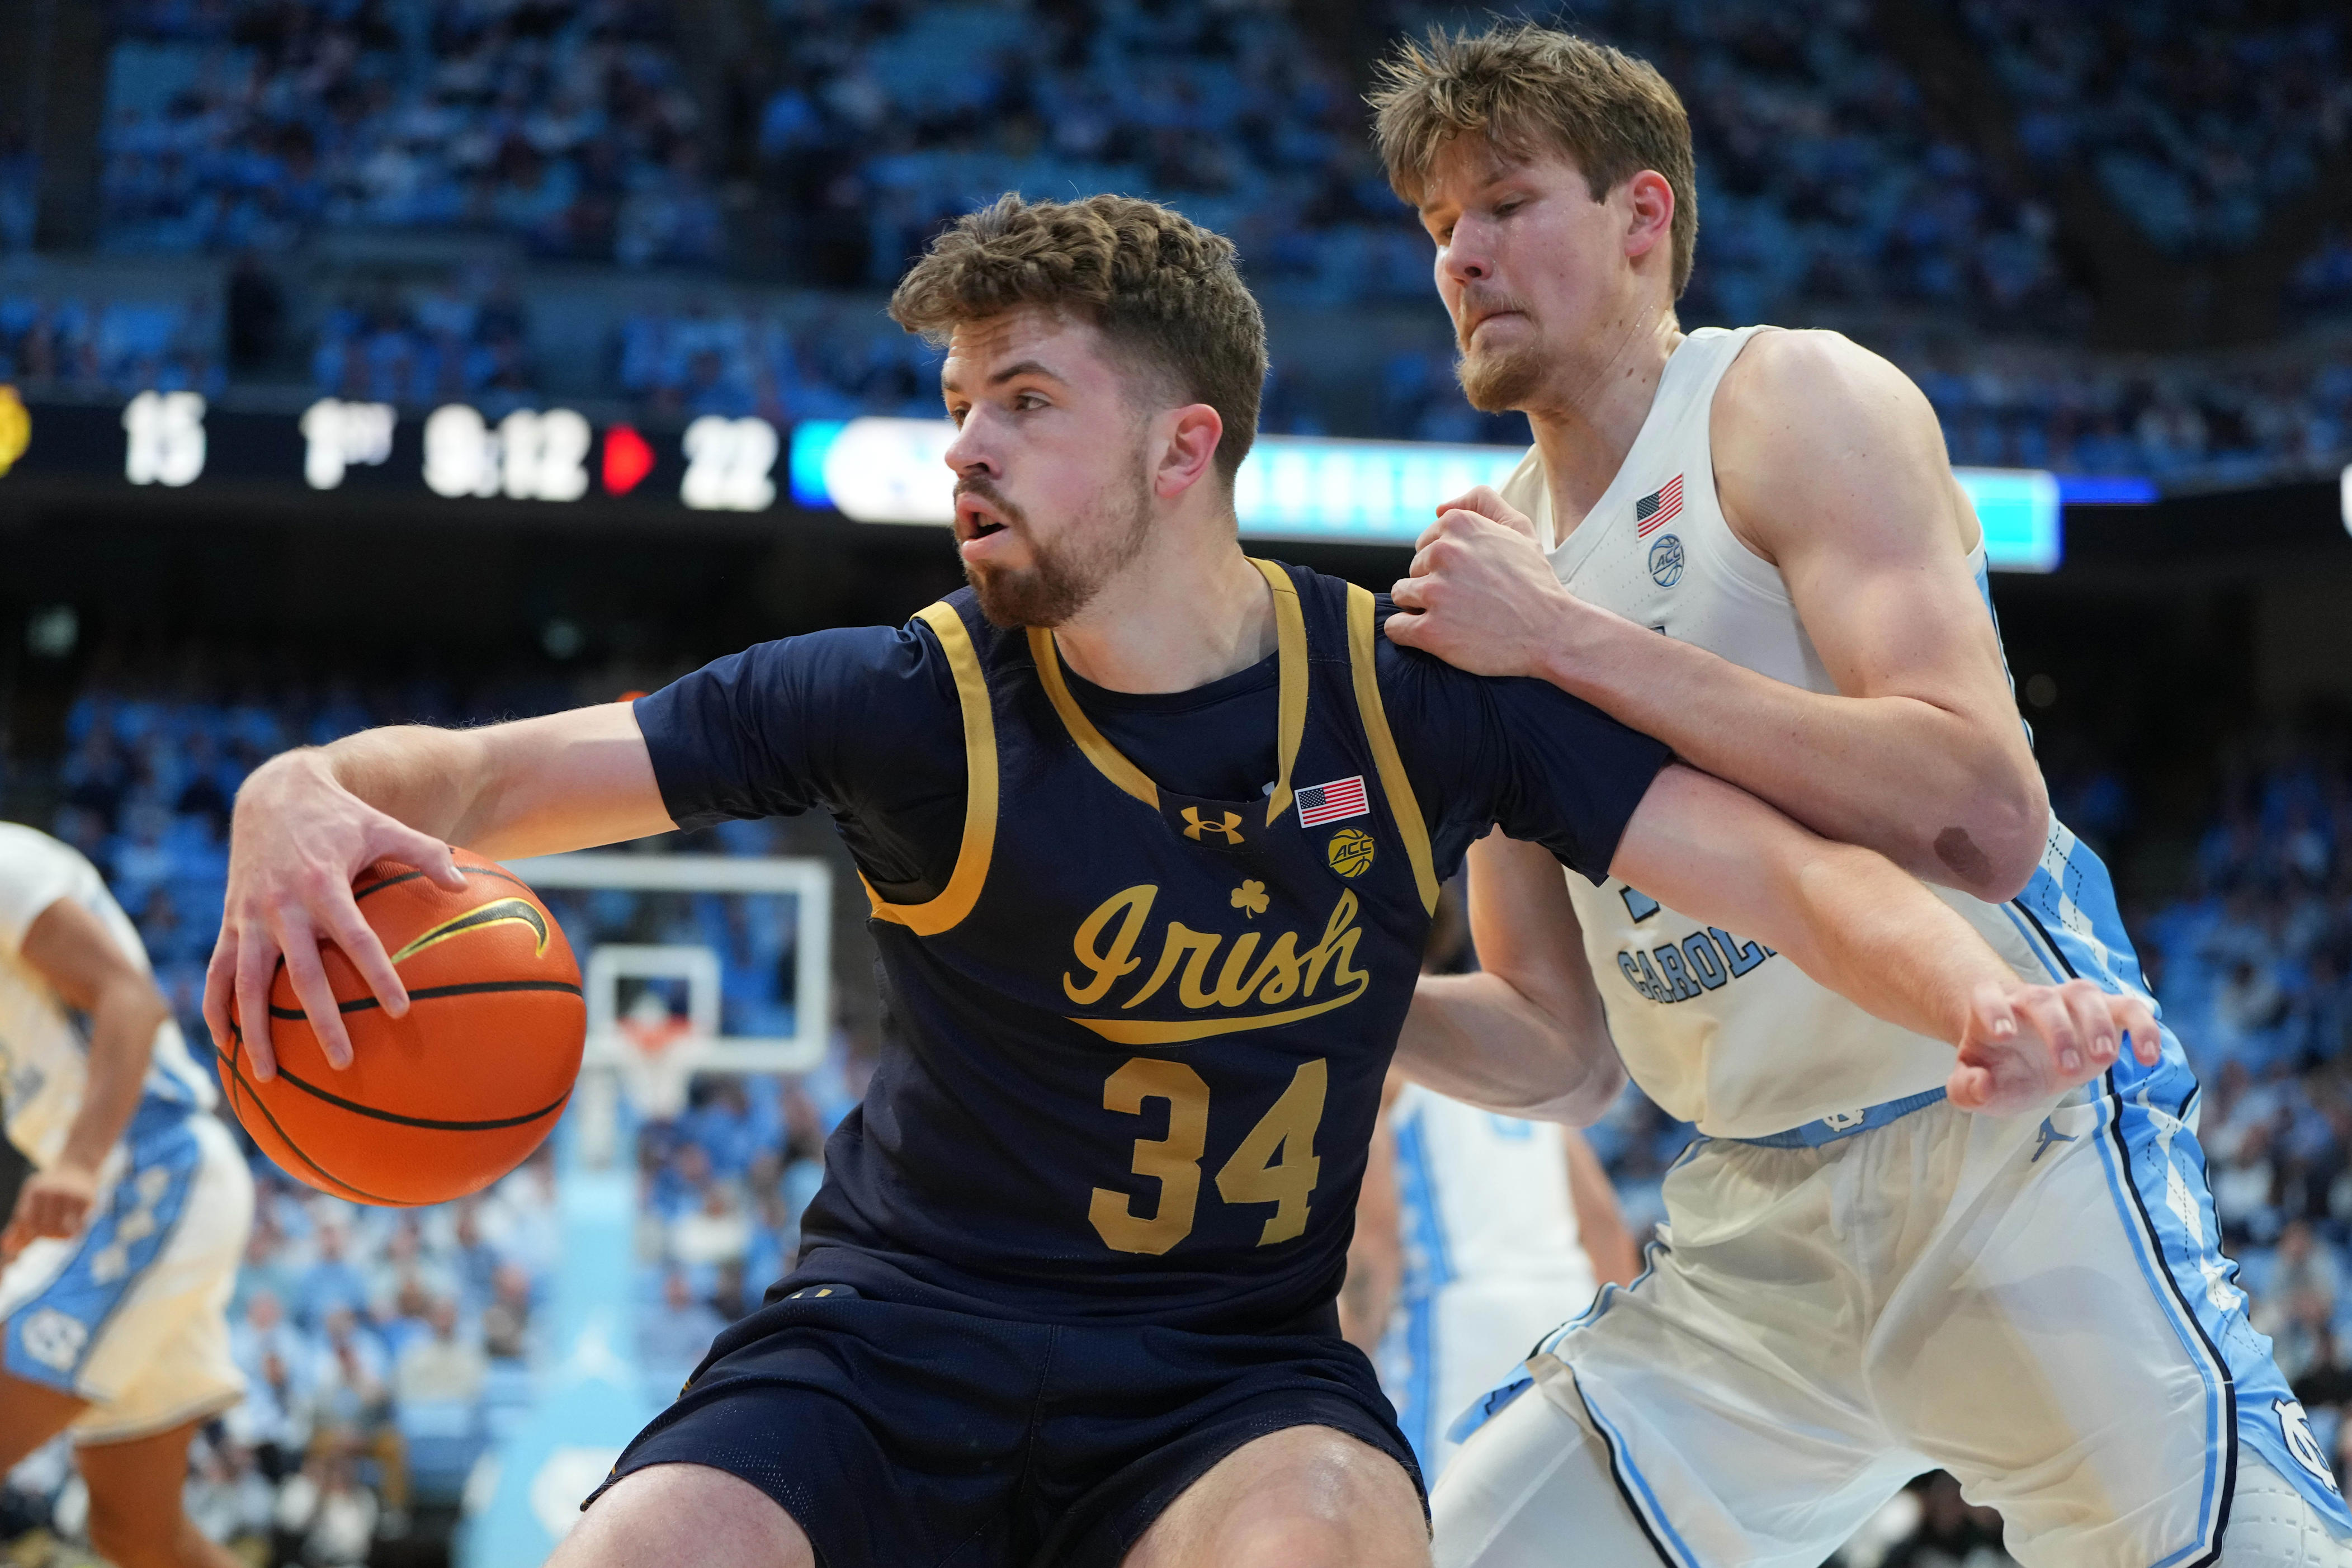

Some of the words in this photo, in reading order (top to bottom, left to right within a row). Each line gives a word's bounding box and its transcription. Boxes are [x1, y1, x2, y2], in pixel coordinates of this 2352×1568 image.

[680, 415, 778, 511] 22
[1654, 543, 1681, 570] ACC
[1333, 838, 1375, 862] ACC
[1063, 884, 1369, 1044] Irish
[1618, 926, 1777, 1004] CAROL
[1088, 1057, 1328, 1256] 34
